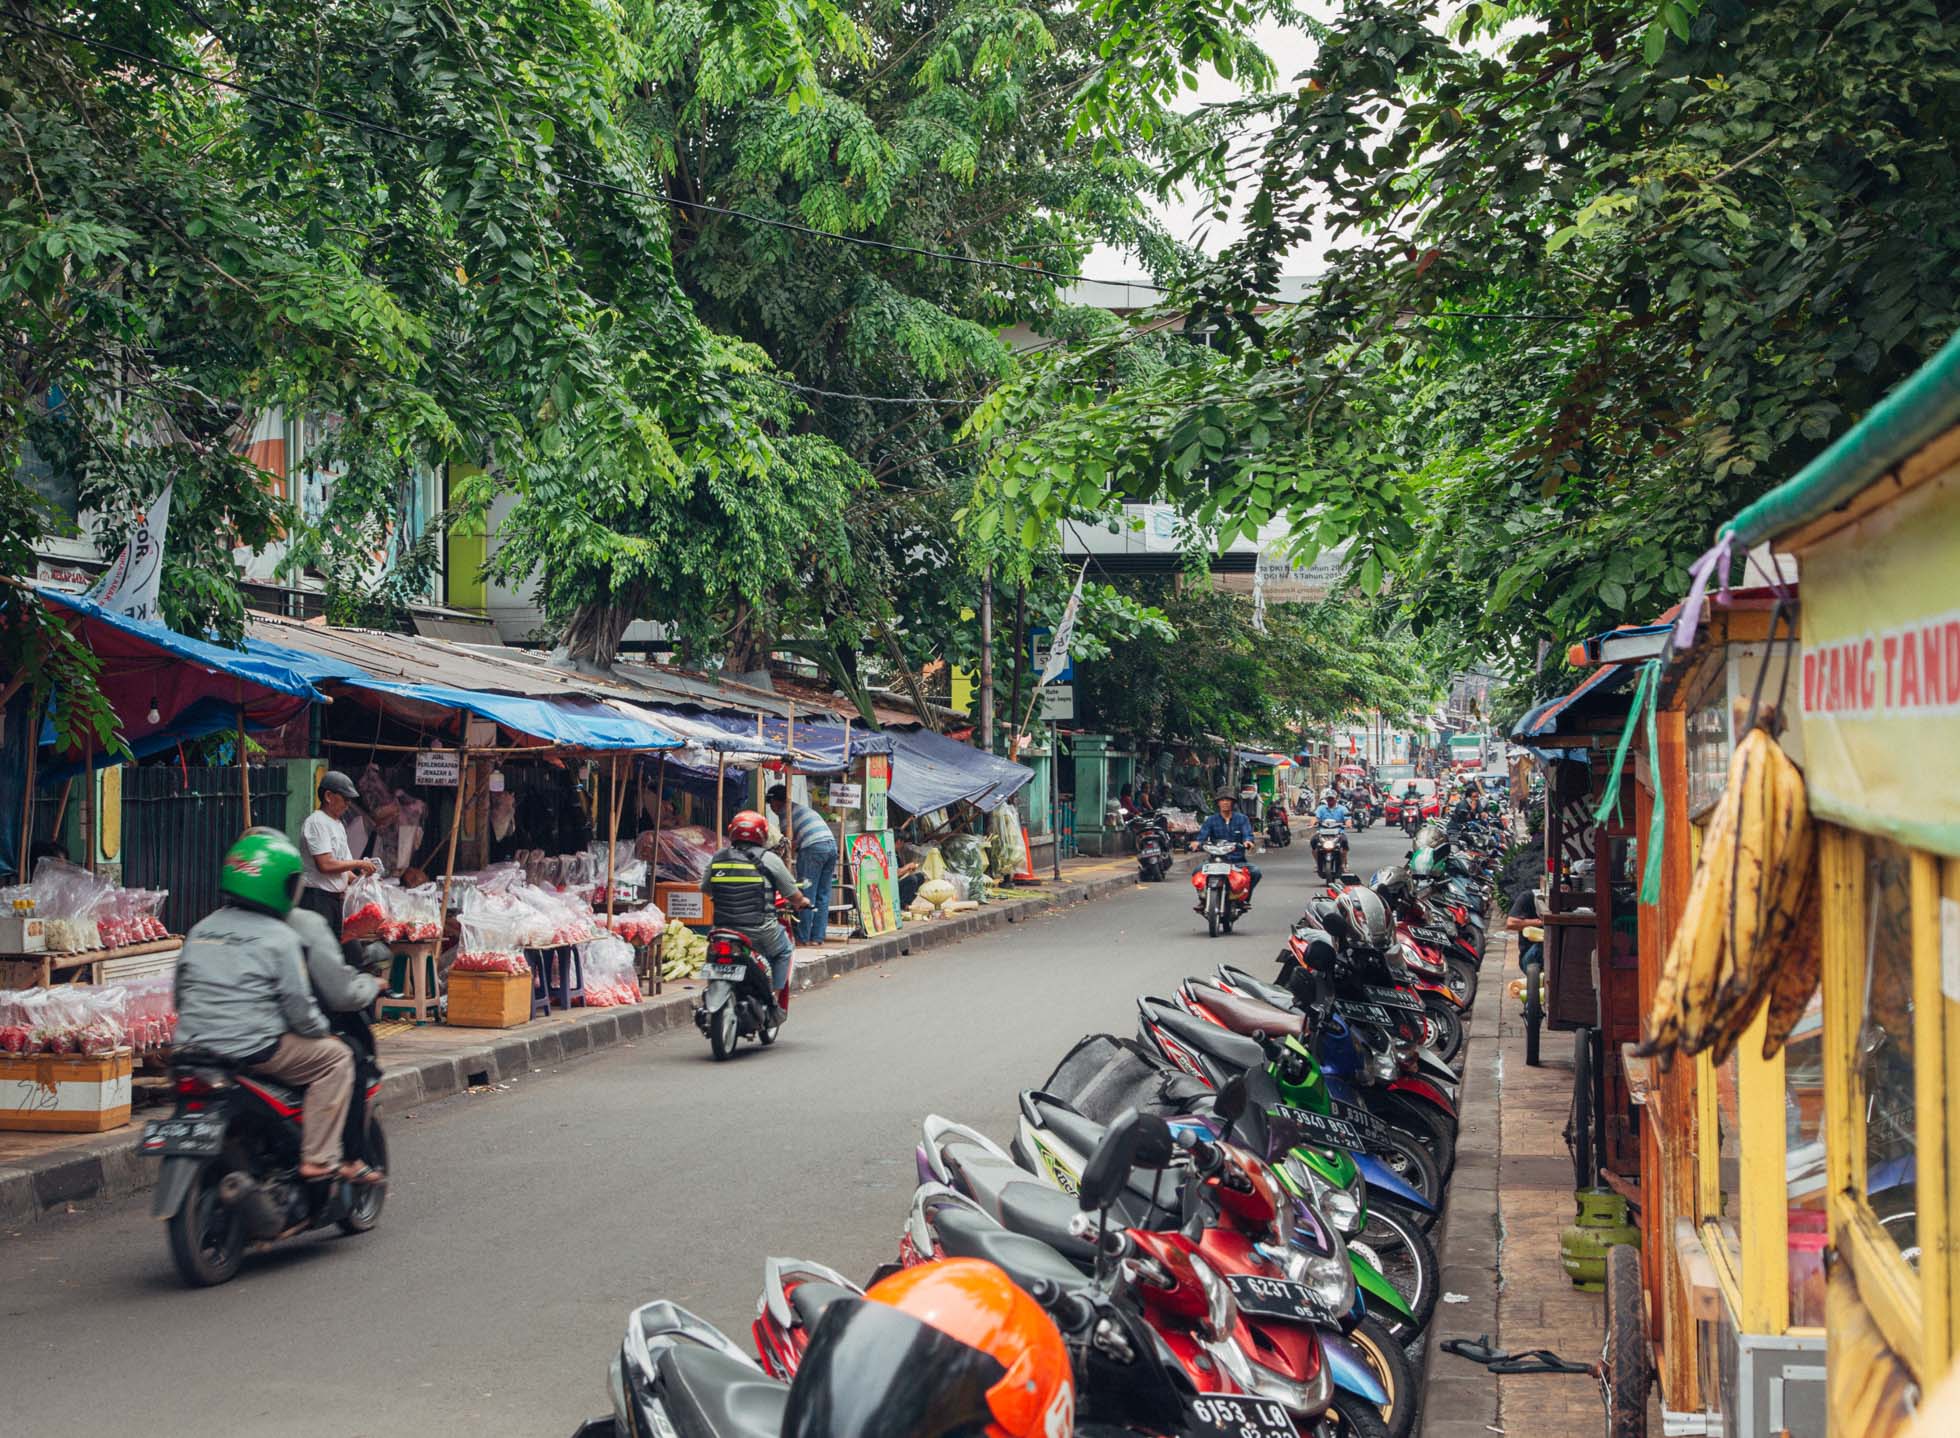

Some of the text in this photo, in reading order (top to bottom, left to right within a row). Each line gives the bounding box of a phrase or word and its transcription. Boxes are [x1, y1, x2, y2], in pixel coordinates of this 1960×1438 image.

[1293, 1110, 1326, 1129] 3940
[1327, 1118, 1354, 1137] BSL
[1247, 1277, 1292, 1299] 6237
[1193, 1399, 1247, 1423] 6153
